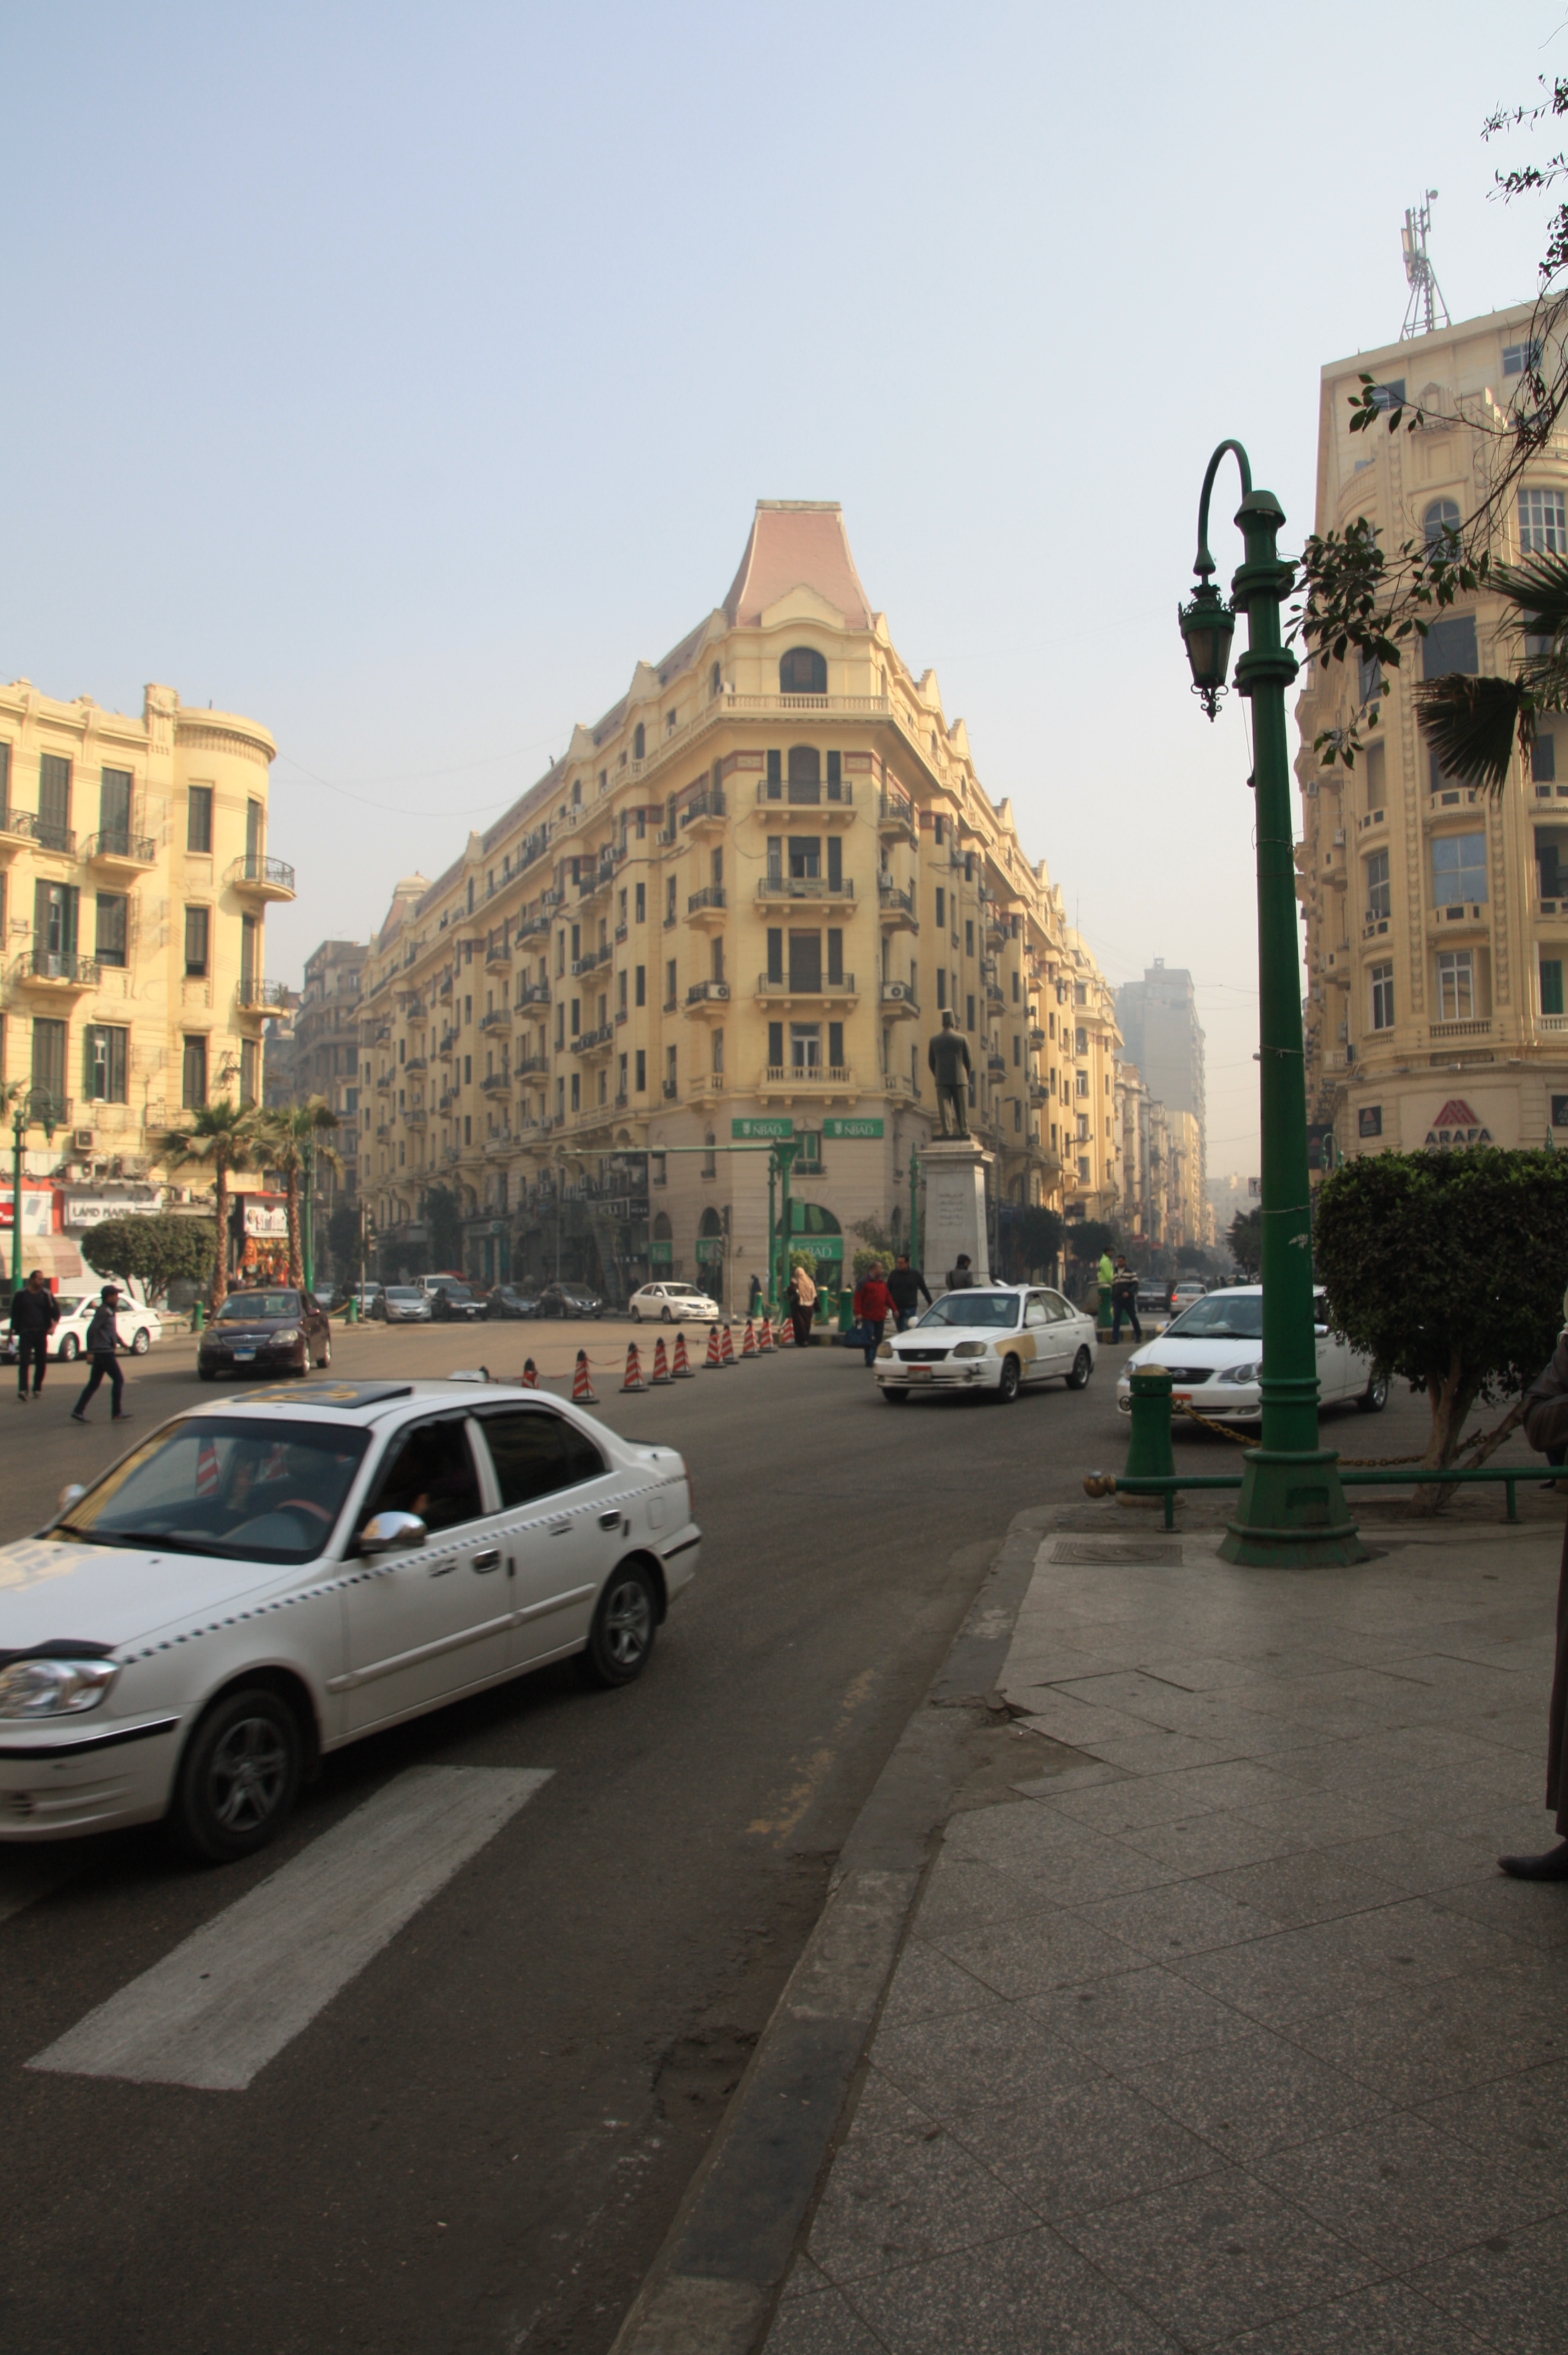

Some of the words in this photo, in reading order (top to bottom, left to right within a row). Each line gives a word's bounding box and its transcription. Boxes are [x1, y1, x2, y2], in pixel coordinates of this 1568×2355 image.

[753, 1125, 782, 1135] NBAD
[844, 1125, 873, 1135] NBAD
[1425, 1129, 1492, 1144] ARAFA
